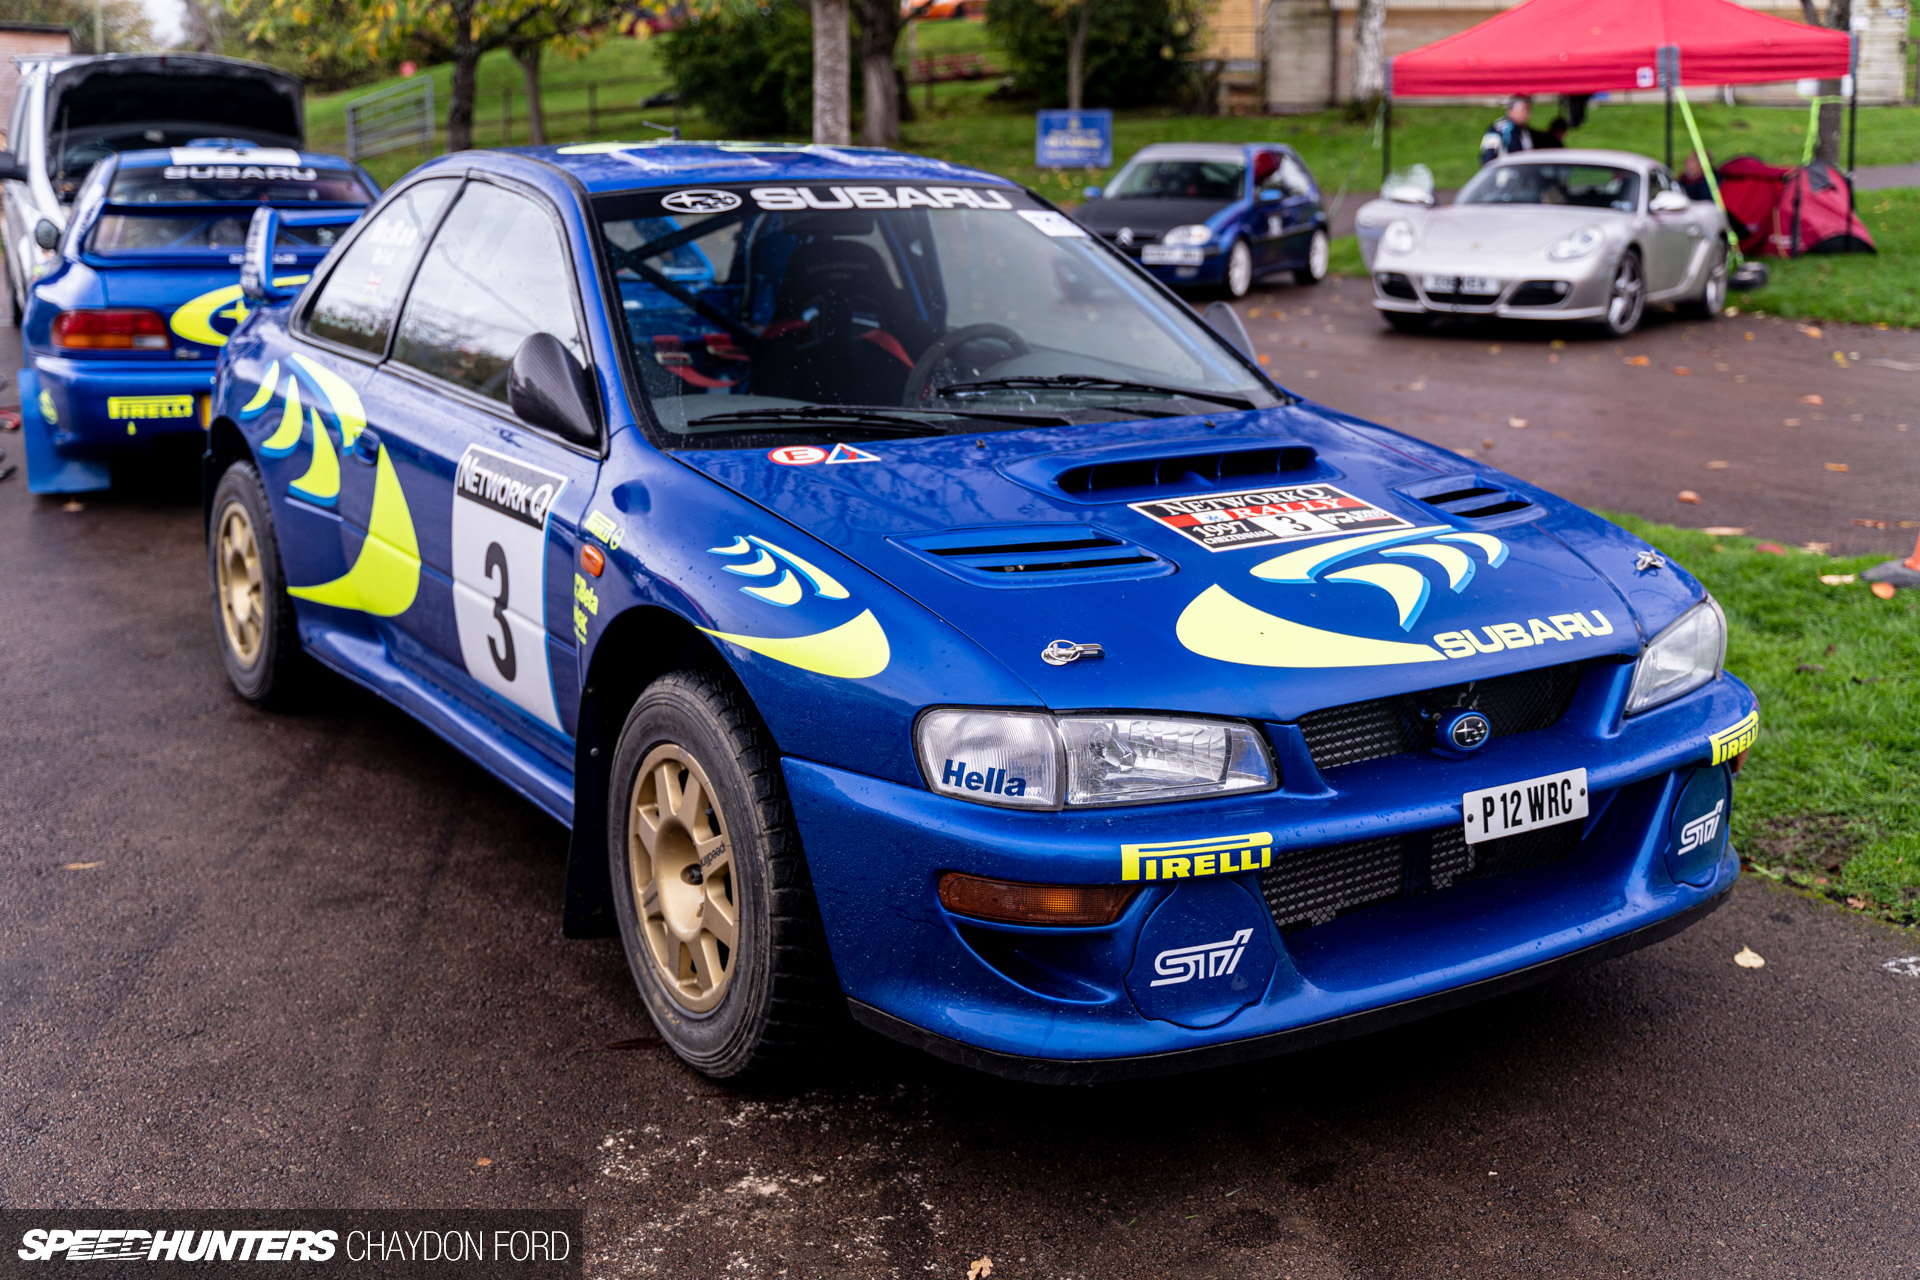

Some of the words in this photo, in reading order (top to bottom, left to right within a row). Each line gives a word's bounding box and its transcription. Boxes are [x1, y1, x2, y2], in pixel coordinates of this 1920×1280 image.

[163, 166, 318, 181] SUBARU
[750, 186, 1013, 211] SUBARU
[107, 394, 194, 419] PIRELLI
[458, 455, 533, 514] NETWORK
[529, 483, 554, 524] Q
[1192, 520, 1250, 539] 1997
[1276, 515, 1312, 532] 3
[1228, 498, 1344, 520] RALLY
[1203, 529, 1274, 546] CHELTENHAM
[484, 541, 516, 683] 3
[1433, 610, 1614, 659] SUBARU
[1708, 710, 1759, 767] PIRELLI
[941, 759, 1027, 797] Hella
[1526, 778, 1573, 823] WRC
[1120, 831, 1274, 881] PIRELLI
